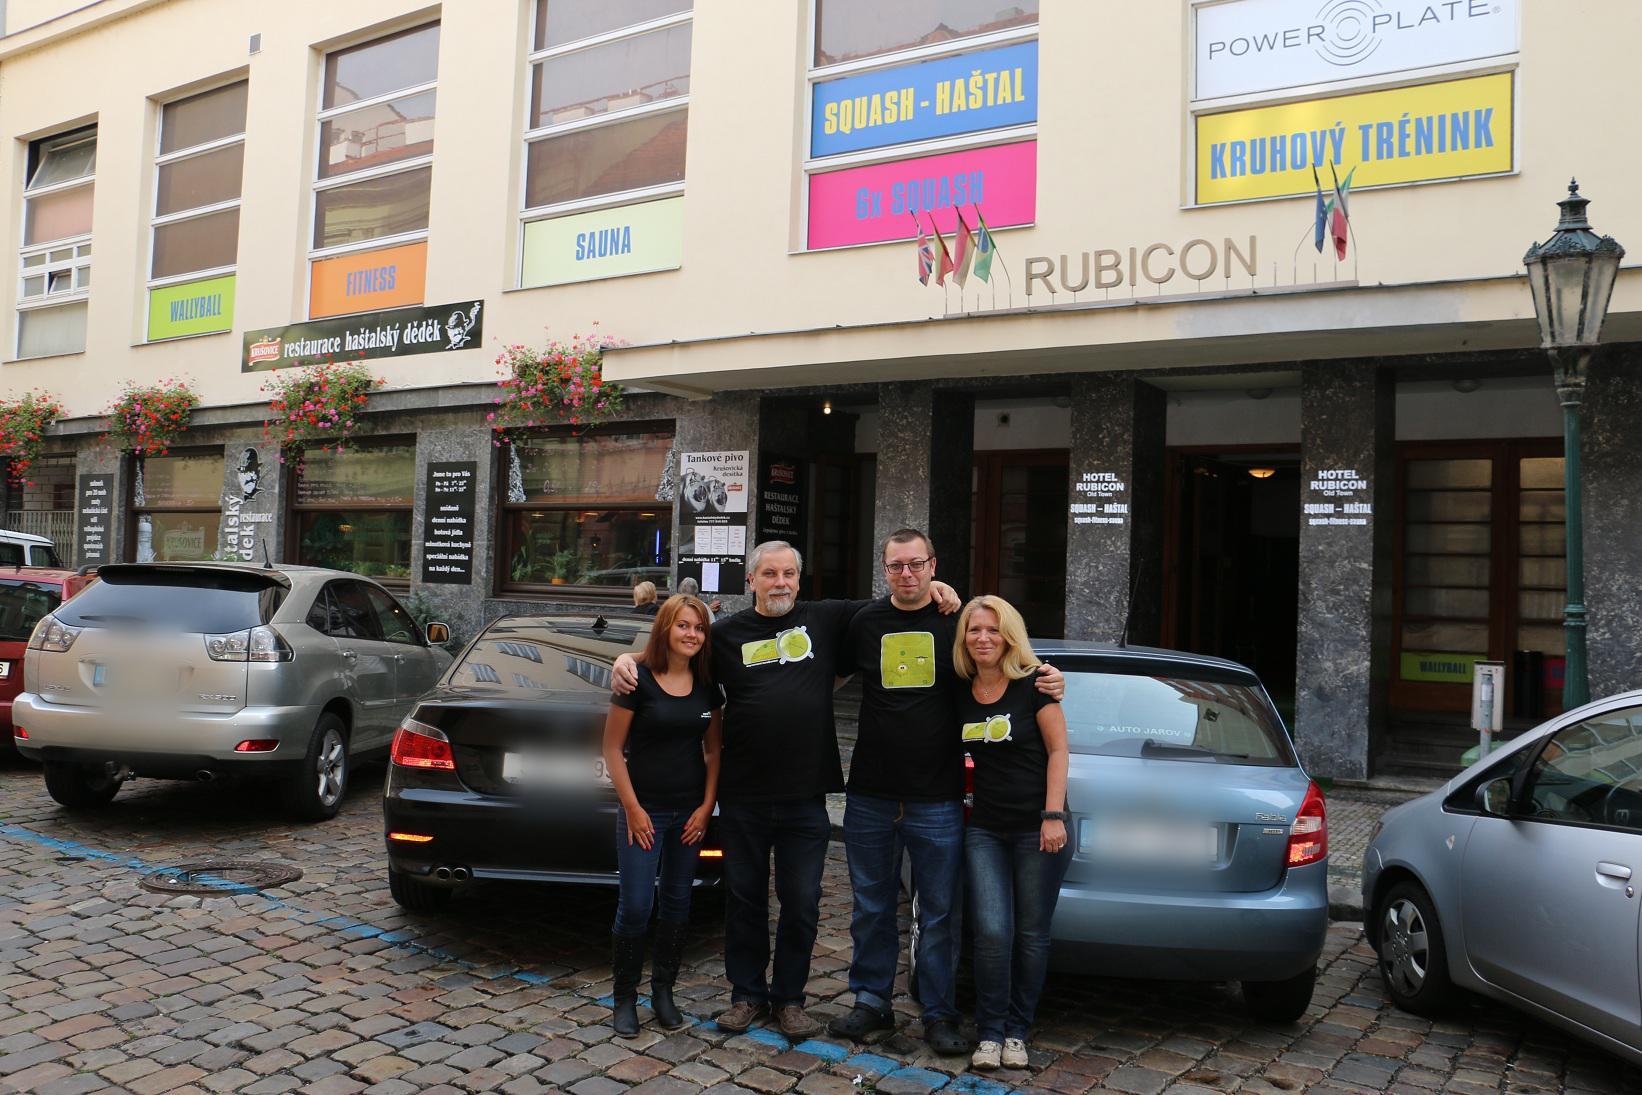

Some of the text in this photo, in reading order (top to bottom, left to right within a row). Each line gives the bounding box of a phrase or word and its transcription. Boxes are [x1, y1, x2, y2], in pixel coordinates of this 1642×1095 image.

[1209, 24, 1327, 60] POWER
[824, 67, 1025, 136] SQUASH - HAŠTAL
[1210, 108, 1495, 180] KRUHOVÝ TRÉNINK
[856, 169, 984, 220] 6x SQUASH
[575, 226, 632, 262] SAUNA
[1025, 235, 1257, 296] RUBICON
[346, 265, 396, 297] FITNESS
[169, 293, 222, 323] WALLYBALL
[284, 318, 442, 358] restaurace haštalský děděk
[687, 453, 744, 464] Tankové pivo
[1082, 472, 1118, 482] HOTEL
[1310, 480, 1367, 490] RUBICON
[1318, 469, 1360, 480] HOTEL
[1076, 482, 1125, 492] RUBICON
[1070, 503, 1097, 514] SQUASH
[1103, 502, 1128, 514] HAŠTAL
[1303, 503, 1335, 515] SQUASH
[1343, 501, 1372, 514] HAŠTAL
[1419, 661, 1467, 675] WALLYBALL
[1110, 725, 1181, 737] AUTO JAROV
